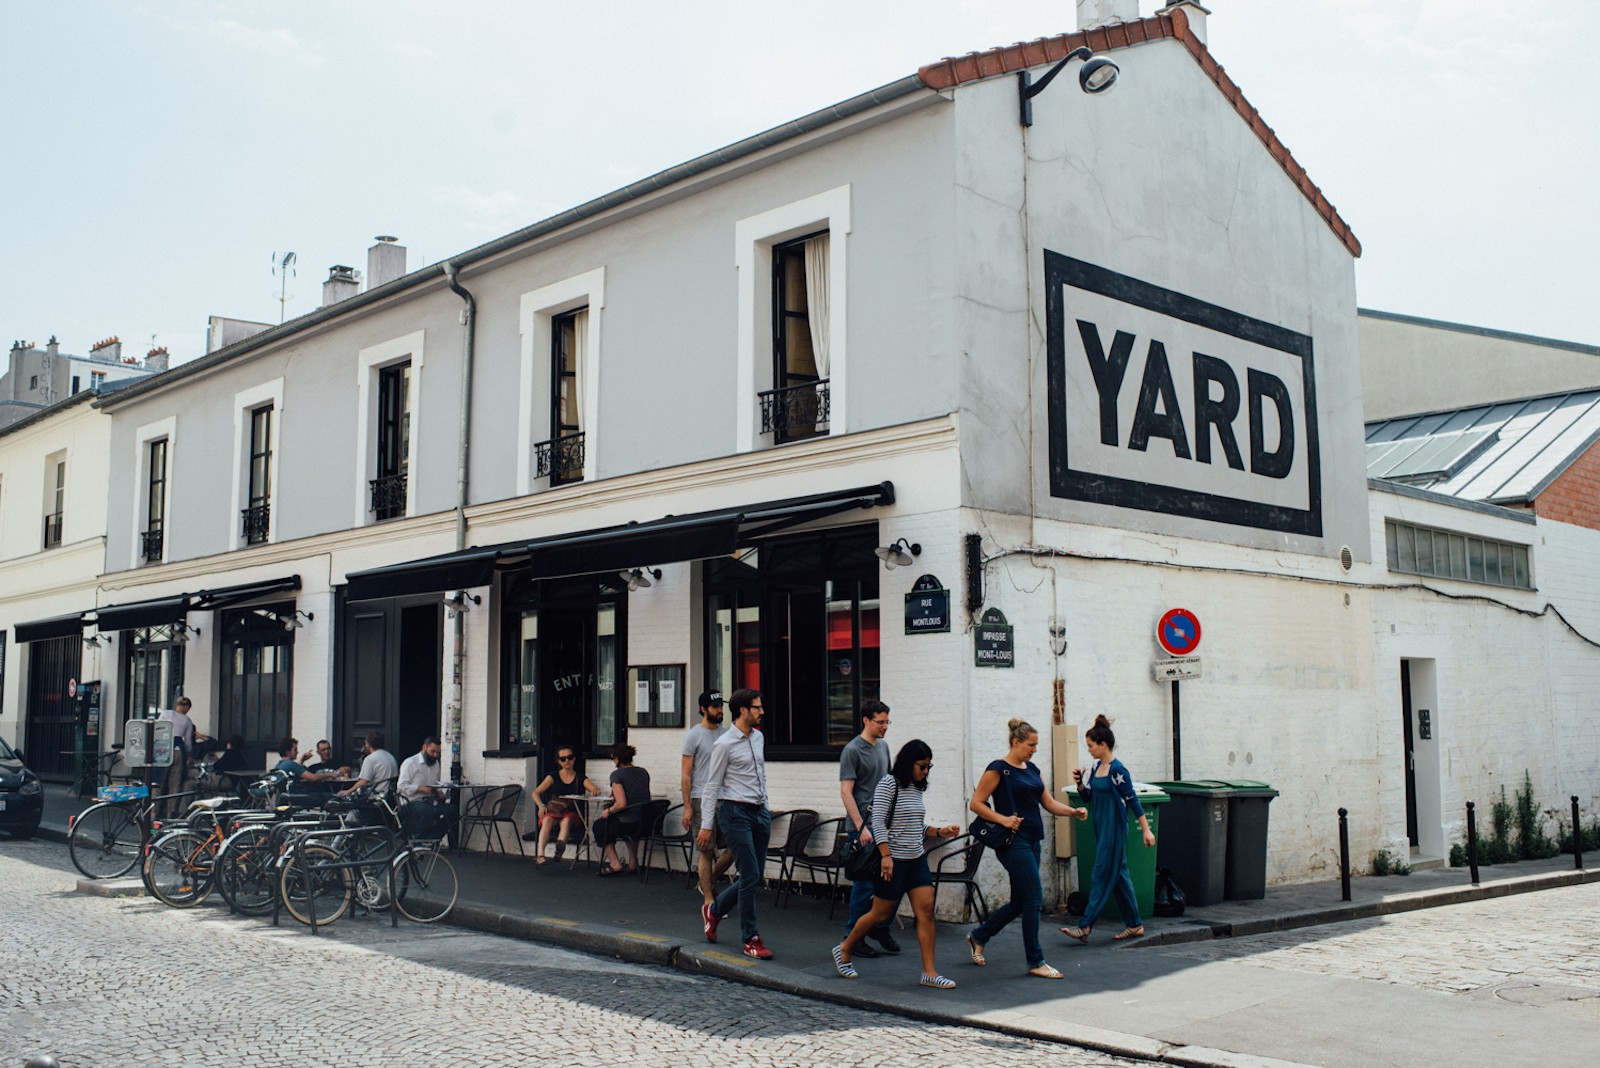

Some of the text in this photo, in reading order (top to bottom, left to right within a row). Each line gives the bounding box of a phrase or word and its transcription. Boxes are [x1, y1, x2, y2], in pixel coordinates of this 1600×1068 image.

[1076, 319, 1295, 479] YARD
[921, 599, 932, 607] RUE
[912, 617, 941, 626] MONTLOUIS
[983, 632, 1006, 641] IMPASSE
[977, 650, 1012, 659] MONT-LOUIS
